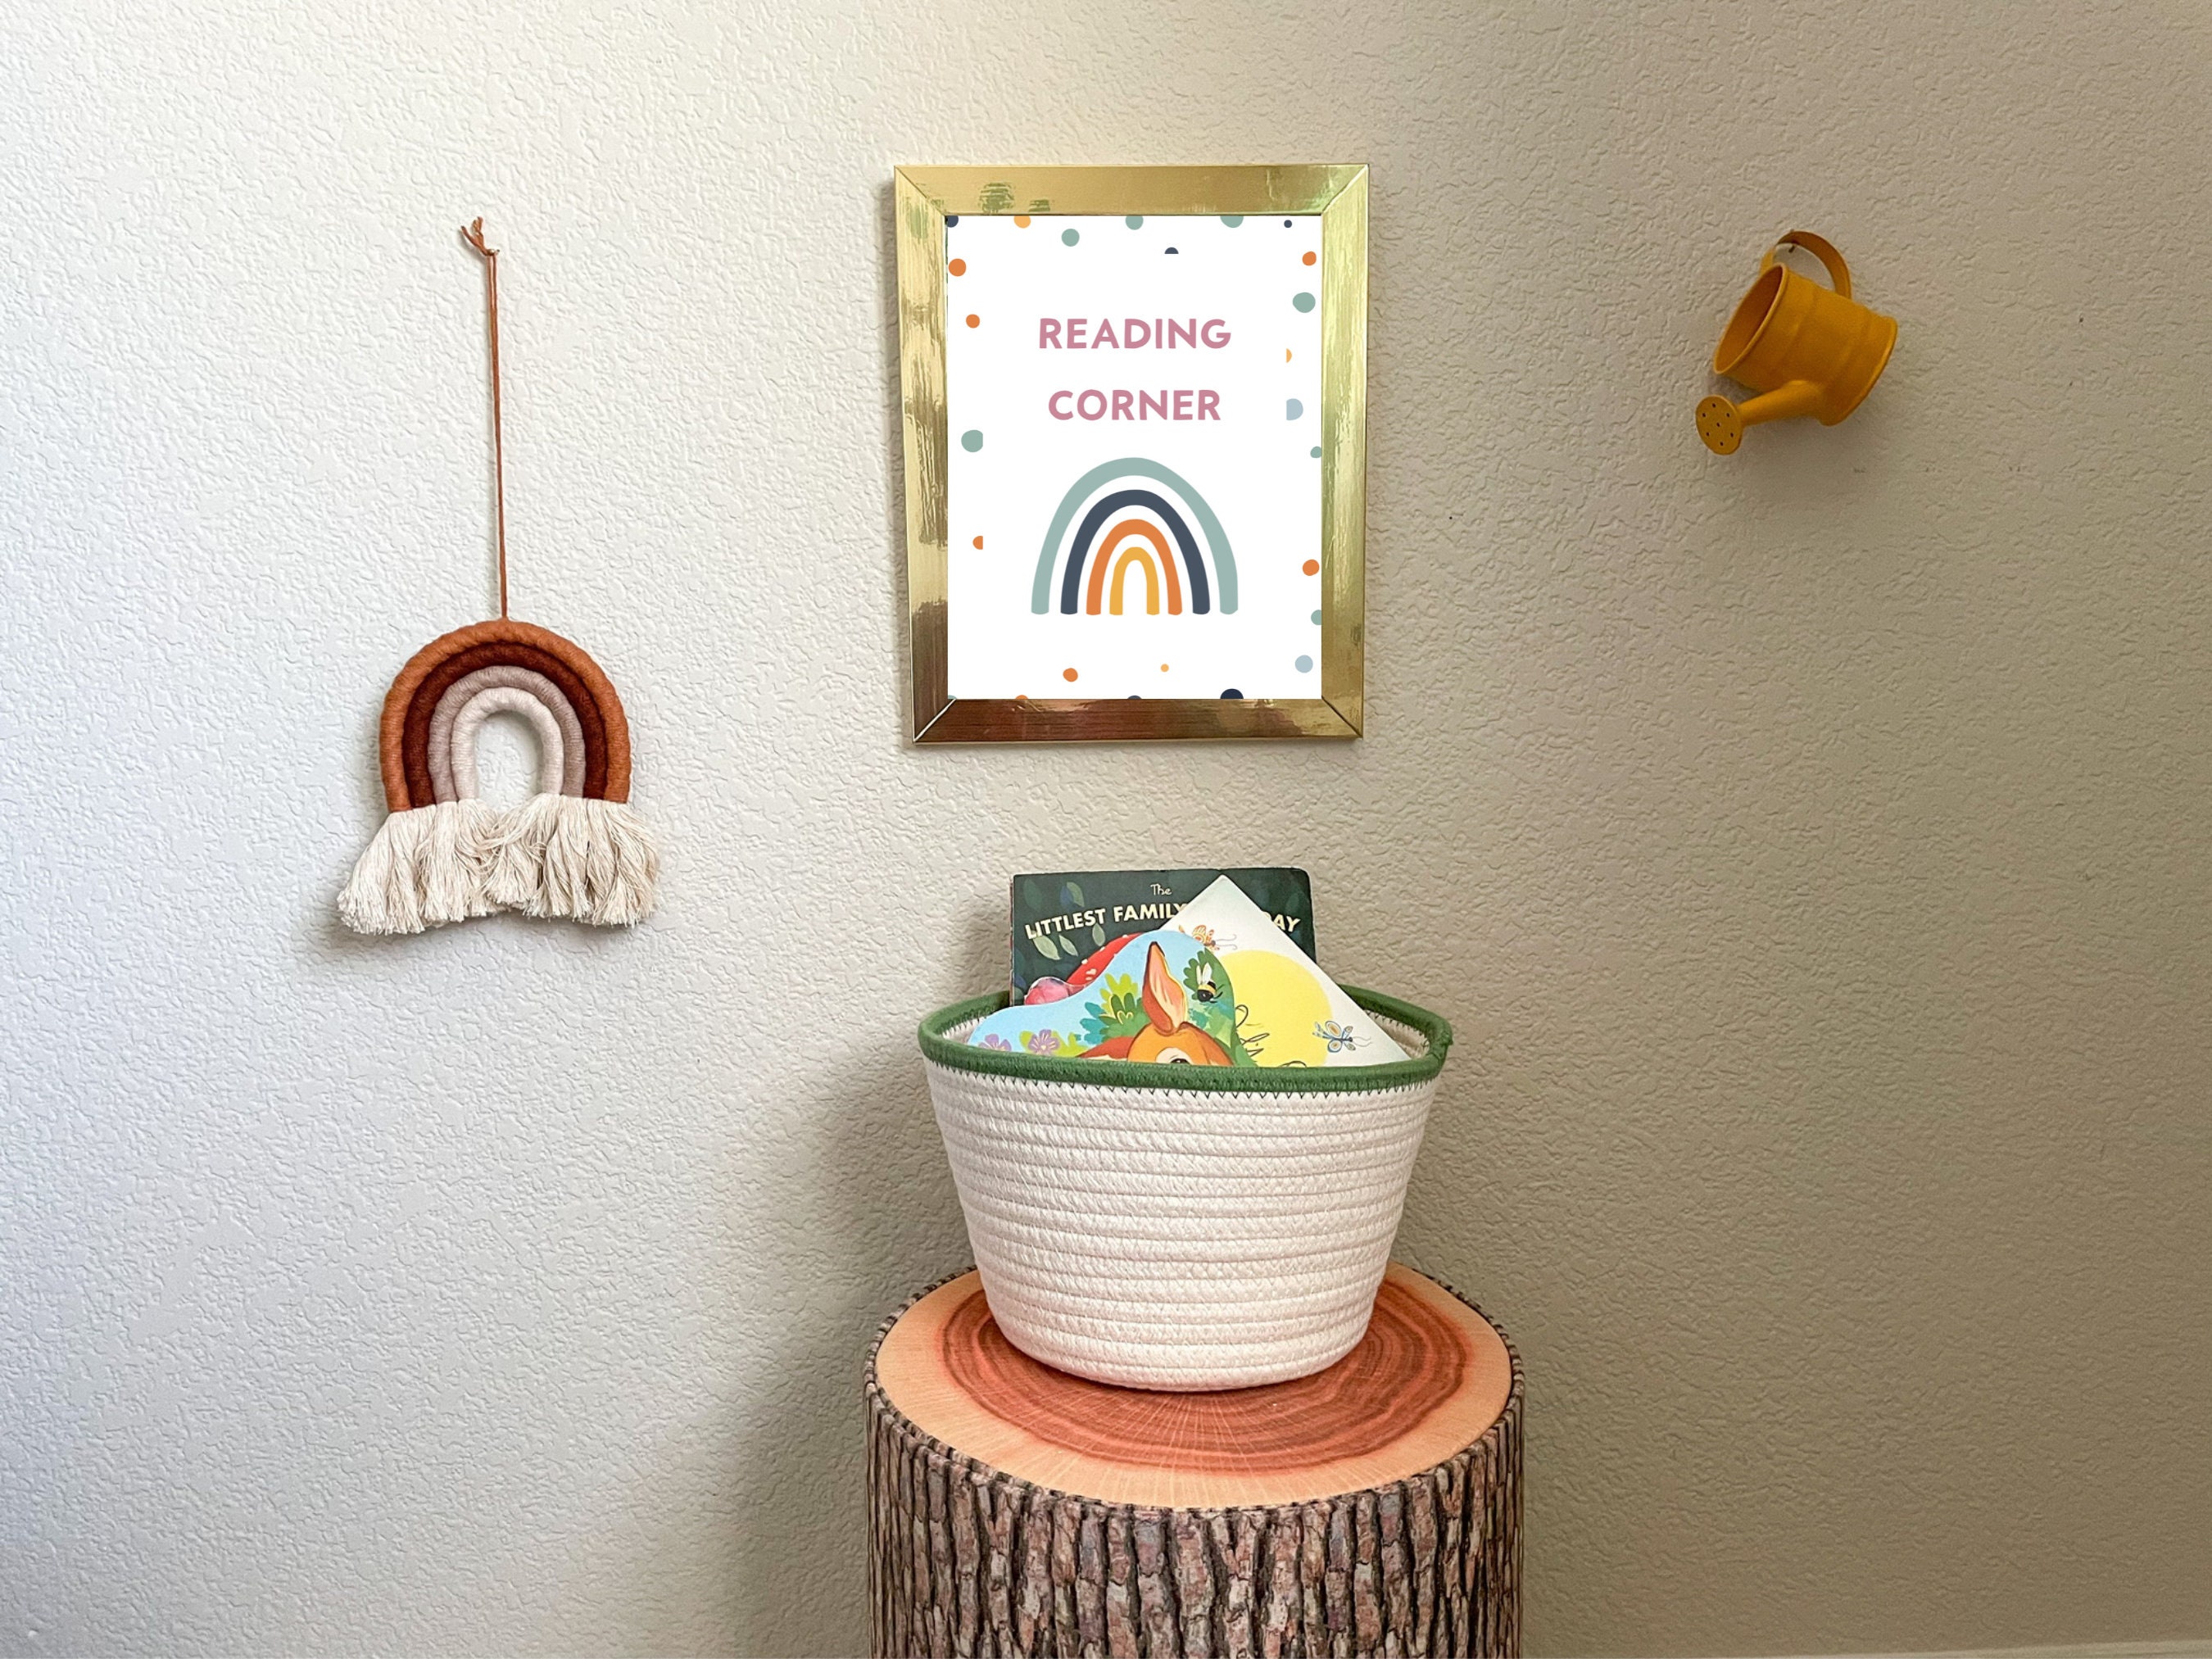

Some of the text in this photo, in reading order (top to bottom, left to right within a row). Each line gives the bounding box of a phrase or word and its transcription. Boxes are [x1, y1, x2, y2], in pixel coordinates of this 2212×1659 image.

[1040, 318, 1231, 349] READING
[1049, 389, 1221, 420] CORNER
[1150, 883, 1172, 896] The
[1025, 909, 1106, 940] LITTLEST
